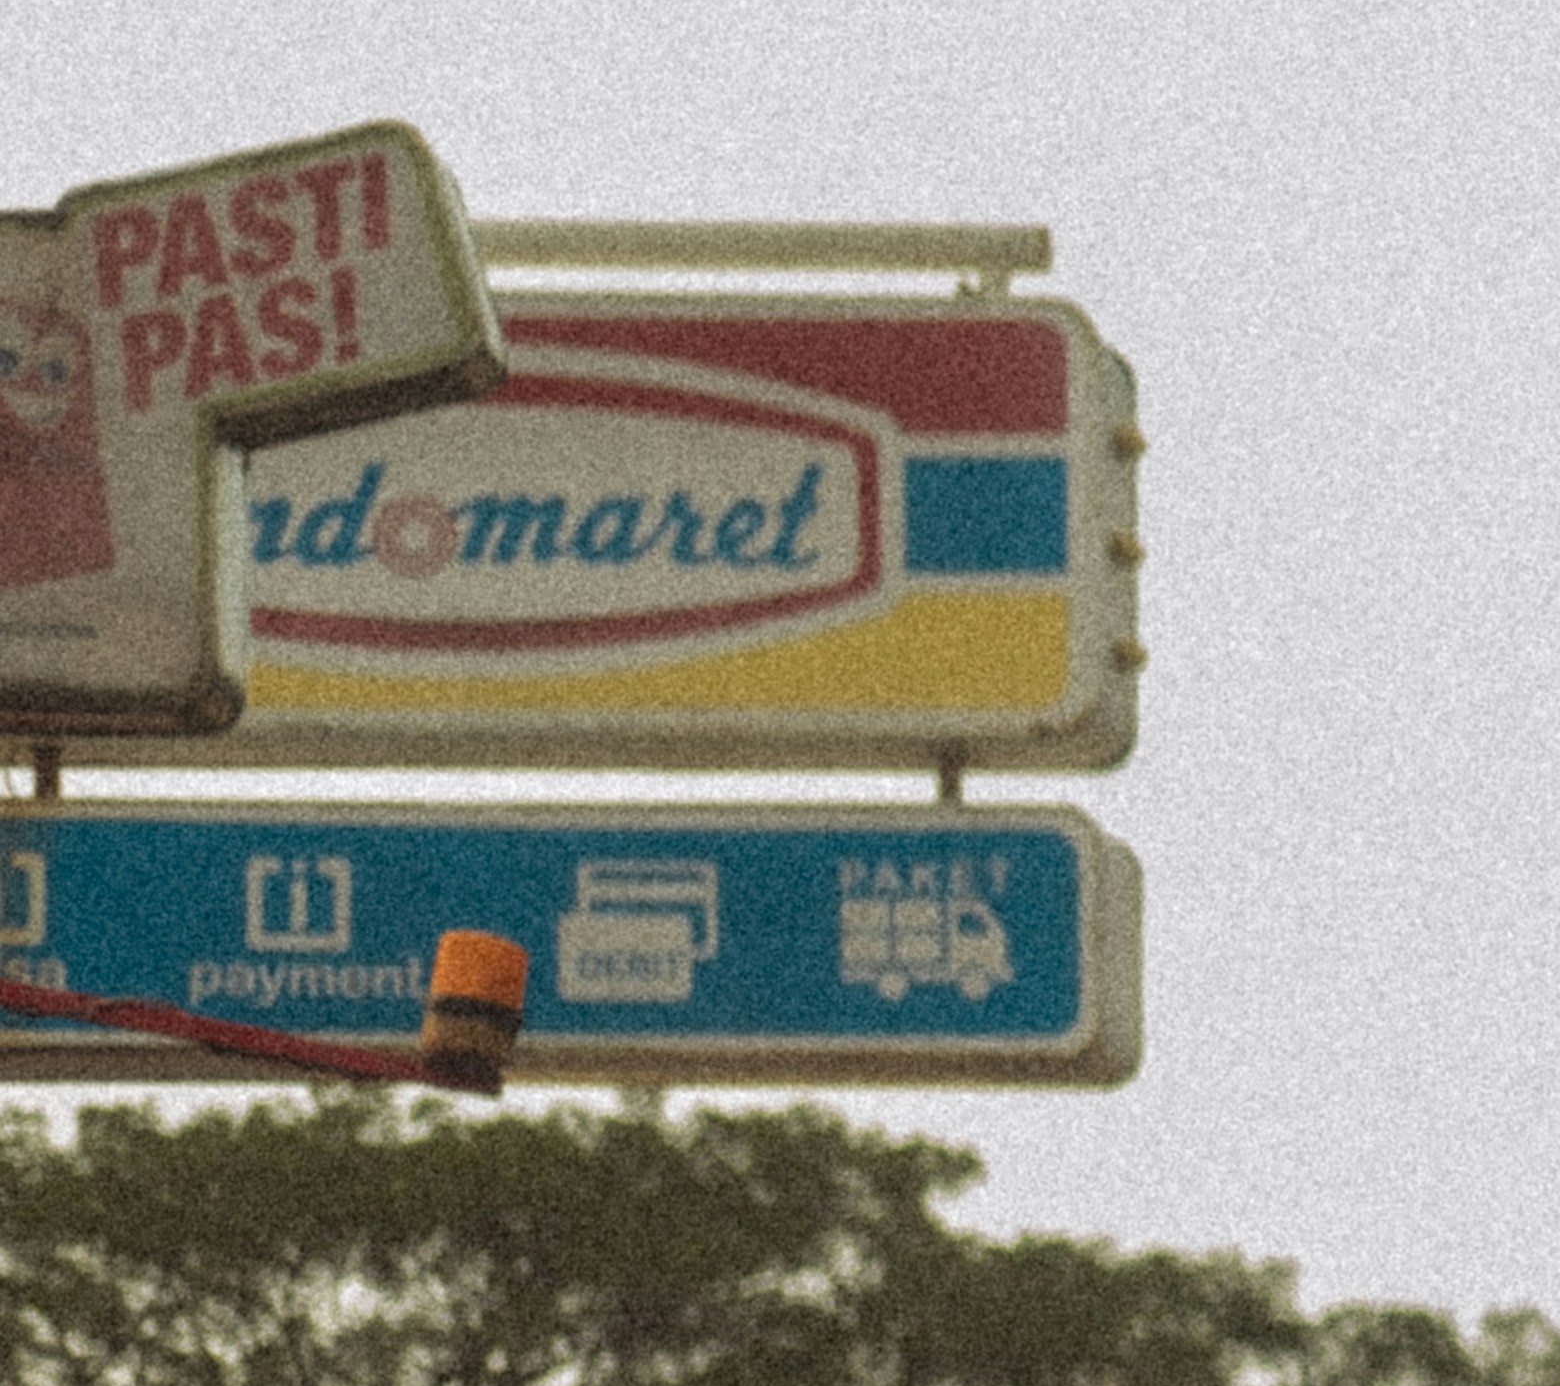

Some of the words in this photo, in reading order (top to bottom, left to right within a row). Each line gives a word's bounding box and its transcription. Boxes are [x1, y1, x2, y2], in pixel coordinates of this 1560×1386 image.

[92, 151, 390, 308] PASTI
[121, 267, 359, 414] PAS!
[188, 958, 430, 1008] payment
